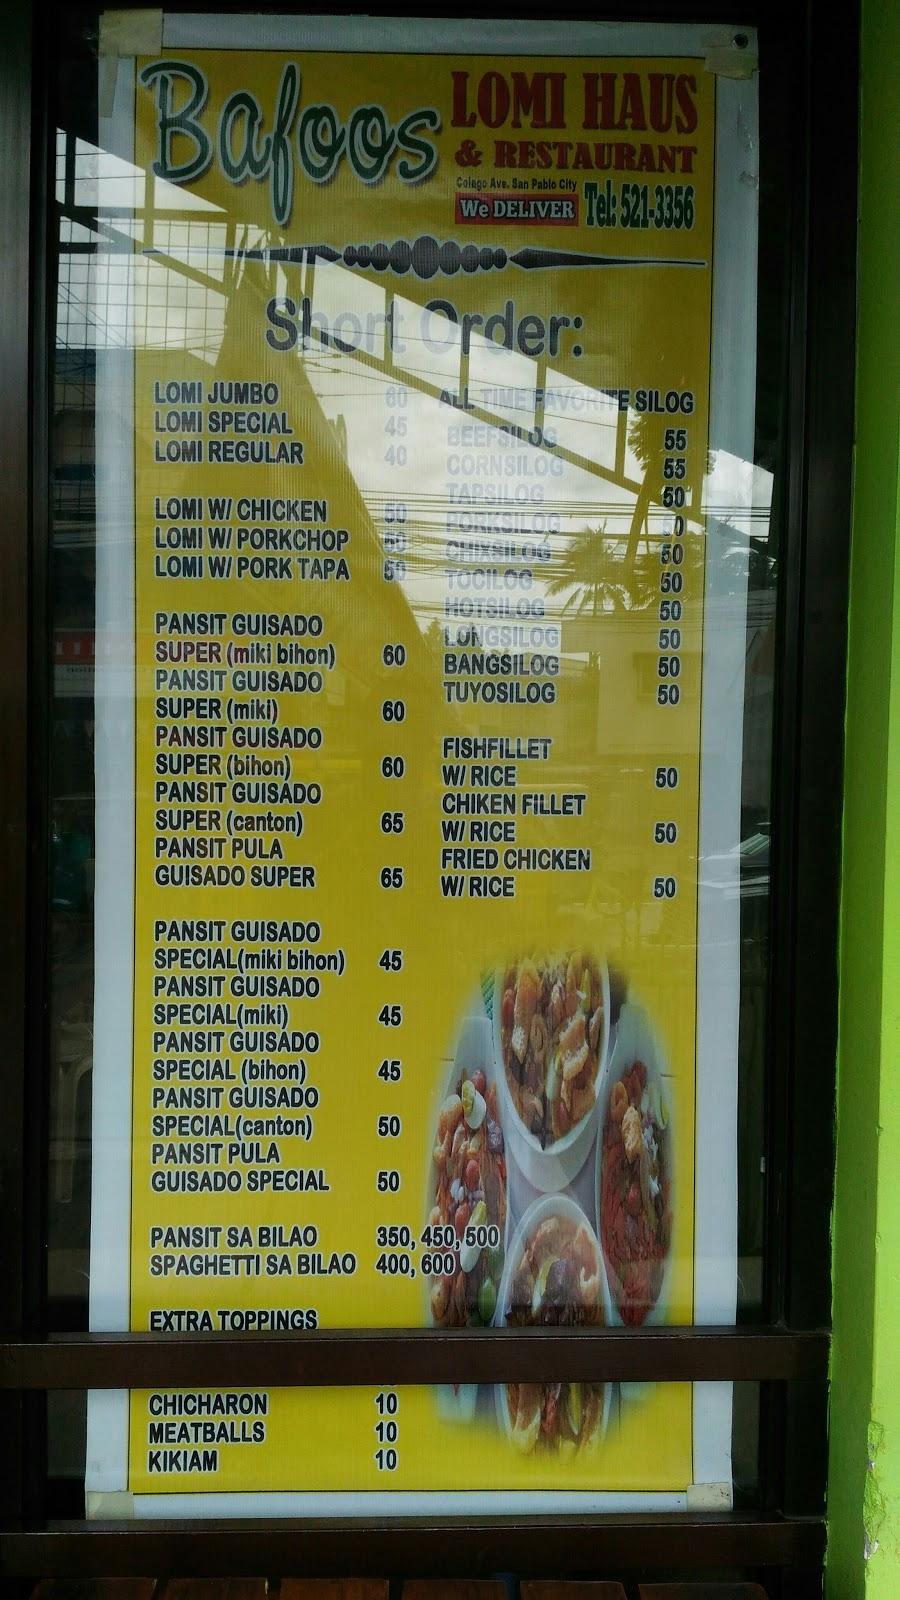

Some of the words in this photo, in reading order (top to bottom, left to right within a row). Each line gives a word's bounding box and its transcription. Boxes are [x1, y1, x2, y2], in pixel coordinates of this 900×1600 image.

[451, 71, 567, 129] LOMI
[582, 72, 698, 134] HAUS
[141, 61, 441, 227] Bafoos
[454, 139, 482, 167] &
[494, 140, 697, 173] RESTAURANT
[490, 178, 510, 189] Ave.
[512, 178, 529, 190] San
[532, 178, 557, 190] Pablo
[560, 179, 577, 192] City
[460, 199, 489, 217] We
[494, 200, 575, 218] DELIVER
[585, 180, 616, 227] Tel:
[621, 184, 695, 229] 521-3356
[266, 297, 403, 354] Short
[420, 300, 584, 357] Order:
[154, 382, 201, 404] LOMI
[208, 383, 279, 404] JUMBO
[438, 388, 475, 410] ALL
[481, 389, 526, 411] TIME
[535, 389, 629, 411] FAVORITE
[635, 390, 693, 413] SILOG
[155, 411, 201, 432] LOMI
[208, 411, 293, 434] SPECIAL
[384, 416, 407, 437] 45
[447, 425, 558, 448] BEEFSILOG
[664, 430, 686, 451] 55
[155, 440, 201, 462] LOMI
[208, 441, 303, 464] REGULAR
[384, 444, 407, 466] 40
[447, 454, 563, 477] CORNSILOG
[664, 458, 686, 479] 55
[445, 483, 544, 505] TAPSILOG
[663, 486, 685, 507] 50
[155, 498, 201, 520] LOMI
[208, 498, 231, 520] W/
[237, 499, 327, 522] CHICKEN
[446, 511, 561, 534] PORKSILOG
[662, 515, 684, 537] 0
[155, 527, 201, 549] LOMI
[208, 527, 232, 549] W/
[238, 528, 349, 551] PORKCHOP
[445, 540, 551, 562] CHIXSILOG
[661, 543, 683, 565] 50
[155, 555, 201, 577] LOMI
[209, 556, 232, 577] W/
[238, 556, 292, 579] PORK
[297, 557, 349, 580] TAPA
[384, 559, 407, 581] 50
[444, 568, 533, 590] TOCILOG
[660, 572, 682, 593] 50
[445, 597, 545, 619] HOTSILOG
[659, 600, 681, 621] 50
[156, 613, 226, 635] PANSIT
[232, 614, 323, 636] GUISADO
[444, 625, 559, 648] LONGSILOG
[659, 629, 681, 649] 50
[156, 641, 221, 663] SUPER
[227, 642, 271, 667] (miki
[277, 642, 335, 669] bihon)
[383, 645, 406, 666] 60
[444, 653, 559, 676] BANGSILOG
[658, 656, 680, 677] 50
[156, 669, 227, 691] PANSIT
[232, 670, 323, 692] GUISADO
[444, 682, 555, 703] TUYOSILOG
[657, 684, 679, 705] 50
[156, 698, 221, 719] SUPER
[227, 699, 277, 724] (miki)
[382, 701, 405, 722] 60
[156, 726, 227, 747] PANSIT
[232, 727, 322, 748] GUISADO
[443, 738, 552, 759] FISHFILLET
[156, 754, 221, 775] SUPER
[227, 754, 290, 780] (bihon)
[382, 757, 404, 777] 60
[443, 766, 466, 786] W/
[471, 766, 516, 787] RICE
[656, 768, 678, 788] 50
[156, 782, 226, 802] PANSIT
[231, 783, 321, 804] GUISADO
[442, 793, 516, 814] CHIKEN
[522, 794, 586, 815] FILLET
[156, 810, 221, 831] SUPER
[227, 811, 303, 836] (canton)
[381, 812, 404, 833] 65
[442, 821, 465, 841] W/
[470, 821, 515, 842] RICE
[655, 823, 677, 843] 50
[156, 838, 226, 858] PANSIT
[231, 838, 283, 859] PULA
[441, 848, 498, 869] FRIED
[504, 849, 591, 870] CHICKEN
[156, 865, 245, 886] GUISADO
[250, 866, 315, 887] SUPER
[381, 868, 403, 888] 65
[441, 876, 464, 897] W/
[469, 876, 515, 897] RICE
[654, 878, 676, 898] 50
[155, 921, 225, 942] PANSIT
[231, 921, 320, 942] GUISADO
[288, 949, 345, 975] bihon)
[379, 950, 402, 971] 45
[154, 976, 225, 997] PANSIT
[230, 976, 320, 997] GUISADO
[379, 1005, 401, 1026] 45
[153, 1032, 224, 1052] PANSIT
[230, 1032, 319, 1053] GUISADO
[153, 1060, 236, 1080] SPECIAL
[241, 1060, 306, 1084] (bihon)
[378, 1061, 401, 1081] 45
[153, 1088, 224, 1108] PANSIT
[229, 1087, 319, 1108] GUISADO
[378, 1116, 400, 1136] 50
[152, 1143, 223, 1164] PANSIT
[228, 1143, 280, 1164] PULA
[152, 1171, 242, 1191] GUISADO
[247, 1170, 329, 1191] SPECIAL
[377, 1171, 400, 1192] 50
[151, 1226, 222, 1248] PANSIT
[227, 1226, 252, 1247] SA
[258, 1226, 317, 1247] BILAO
[377, 1226, 415, 1249] 350,
[421, 1226, 460, 1250] 450,
[466, 1226, 499, 1247] 500
[150, 1254, 260, 1276] SPAGHETTI
[266, 1254, 292, 1275] SA
[298, 1254, 356, 1275] BILAO
[376, 1254, 415, 1277] 400,
[421, 1254, 455, 1275] 600
[150, 1310, 213, 1331] EXTRA
[217, 1310, 317, 1330] TOPPINGS
[150, 1393, 267, 1415] CHICHARON
[375, 1393, 398, 1414] 10
[149, 1421, 265, 1443] MEATBALLS
[375, 1421, 397, 1442] 10
[148, 1450, 217, 1472] KIKIAM
[375, 1450, 397, 1470] 10
